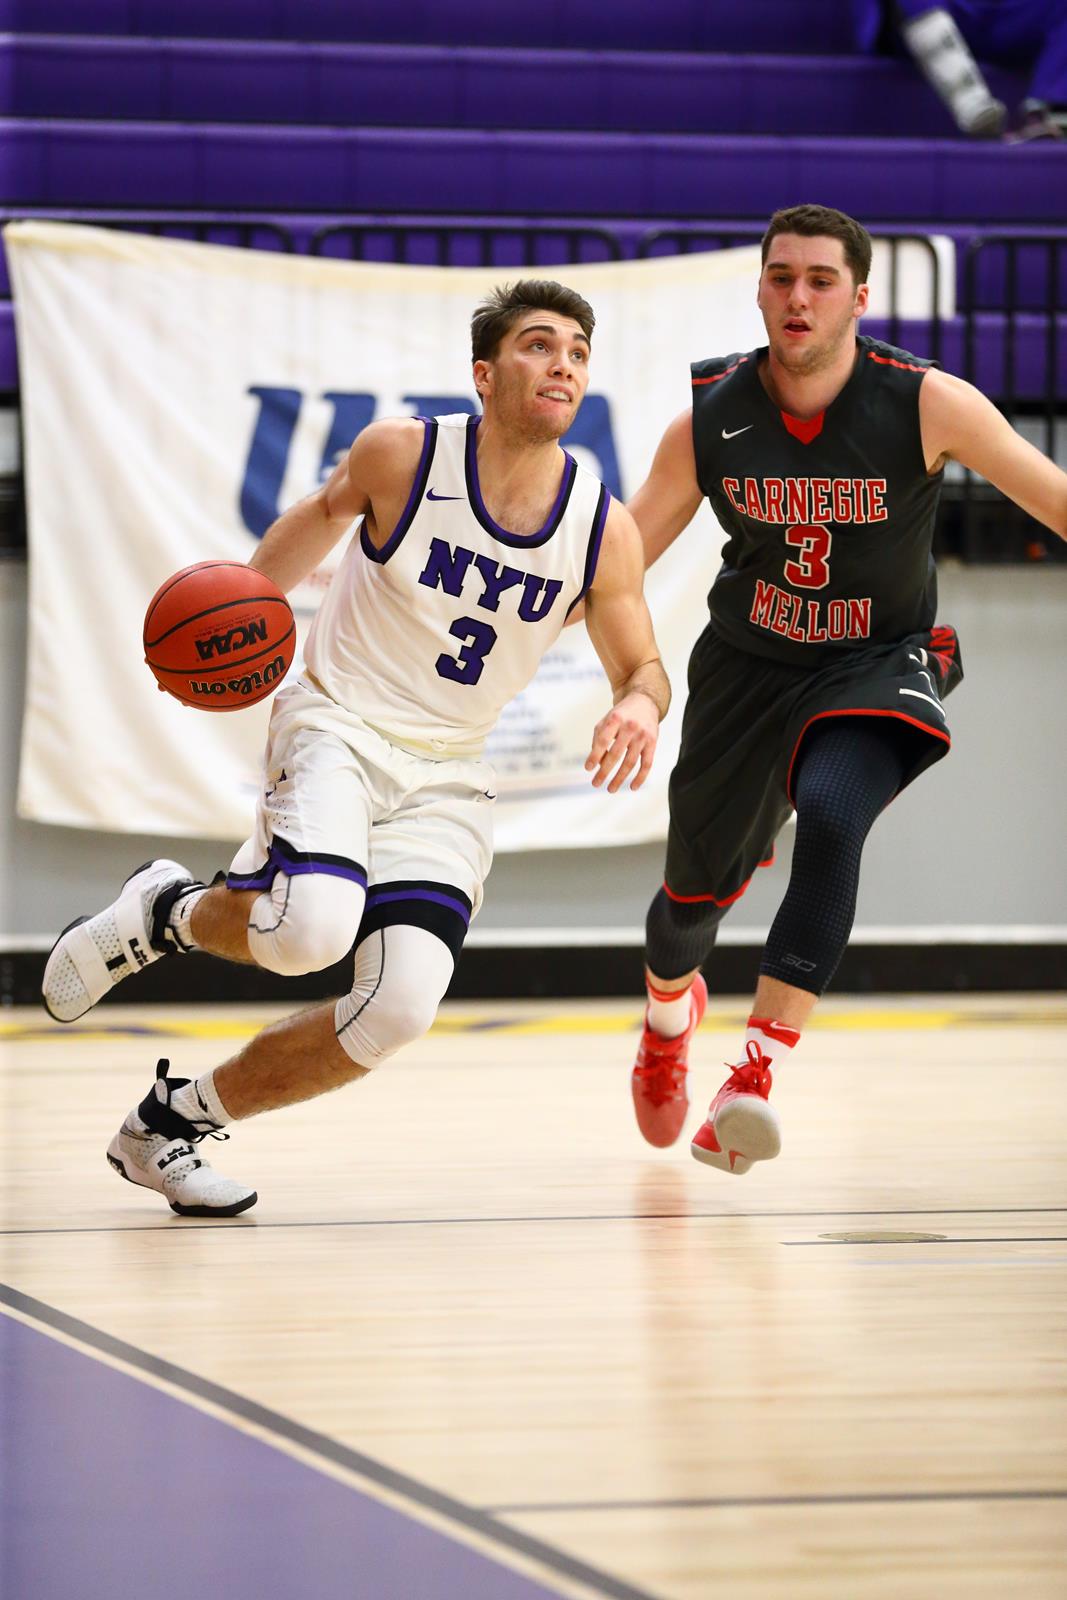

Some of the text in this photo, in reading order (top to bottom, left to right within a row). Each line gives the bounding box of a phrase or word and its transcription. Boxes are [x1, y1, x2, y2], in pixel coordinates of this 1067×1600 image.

[722, 477, 888, 525] CARNEGIE
[418, 537, 564, 622] NYU
[783, 523, 832, 590] 3
[195, 617, 268, 661] NCAA
[750, 579, 872, 643] MELLON
[189, 655, 286, 695] Wilson
[435, 616, 498, 685] 3
